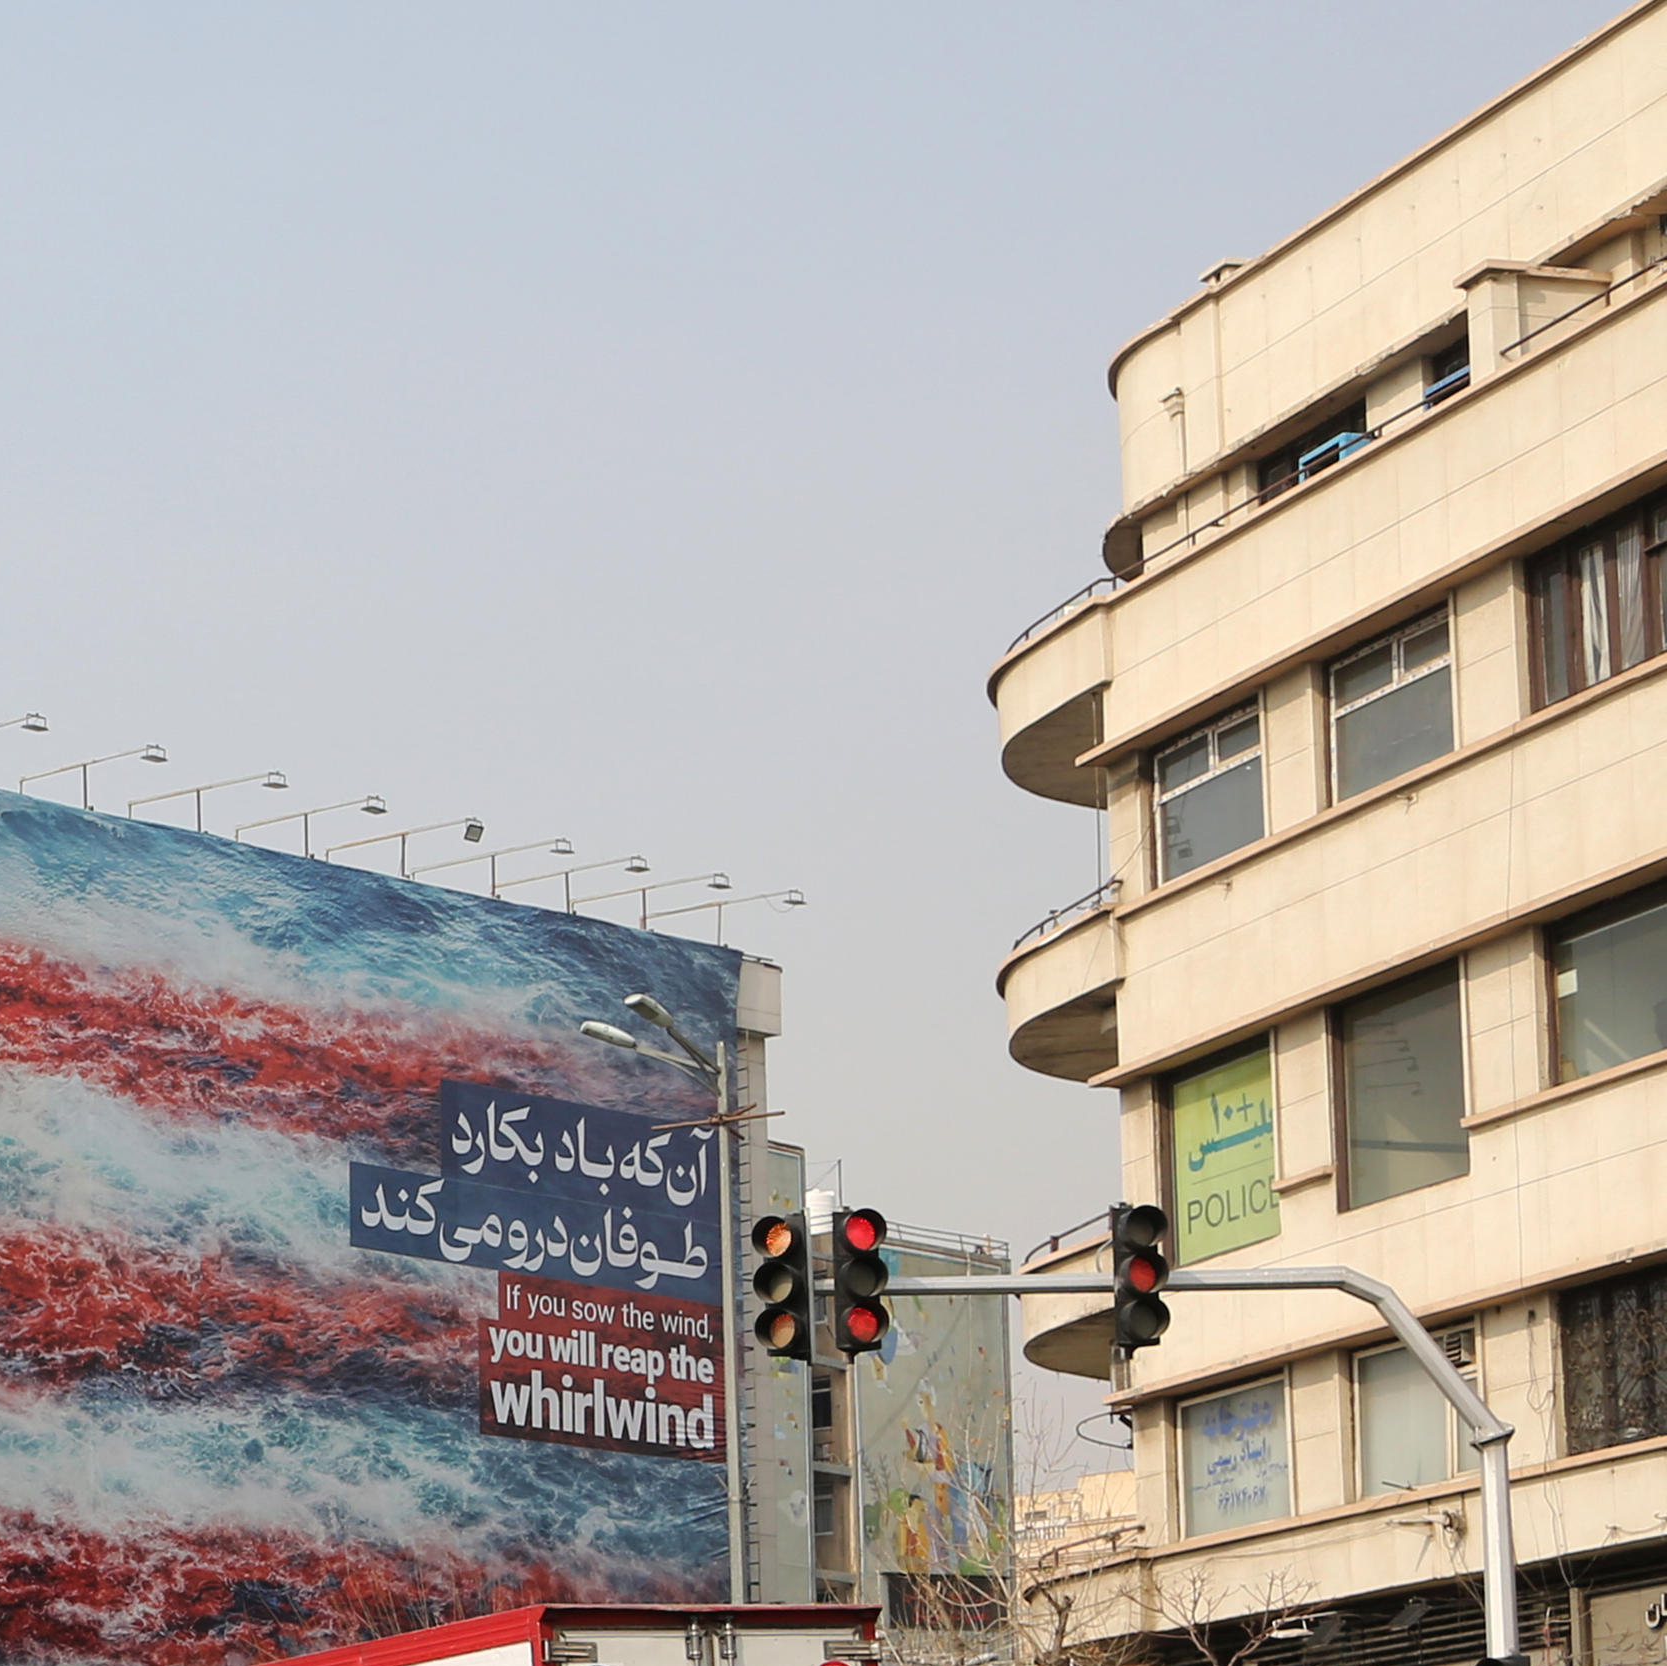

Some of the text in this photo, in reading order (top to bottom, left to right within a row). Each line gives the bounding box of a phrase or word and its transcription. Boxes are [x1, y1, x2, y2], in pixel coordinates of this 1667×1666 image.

[451, 1100, 714, 1207] آن که باد بکارد
[1188, 1097, 1273, 1172] لیس
[569, 1206, 708, 1290] طوفان
[506, 1284, 714, 1344] If you sow the wind,
[488, 1326, 715, 1384] you will reap the
[489, 1369, 716, 1450] whirlwind
